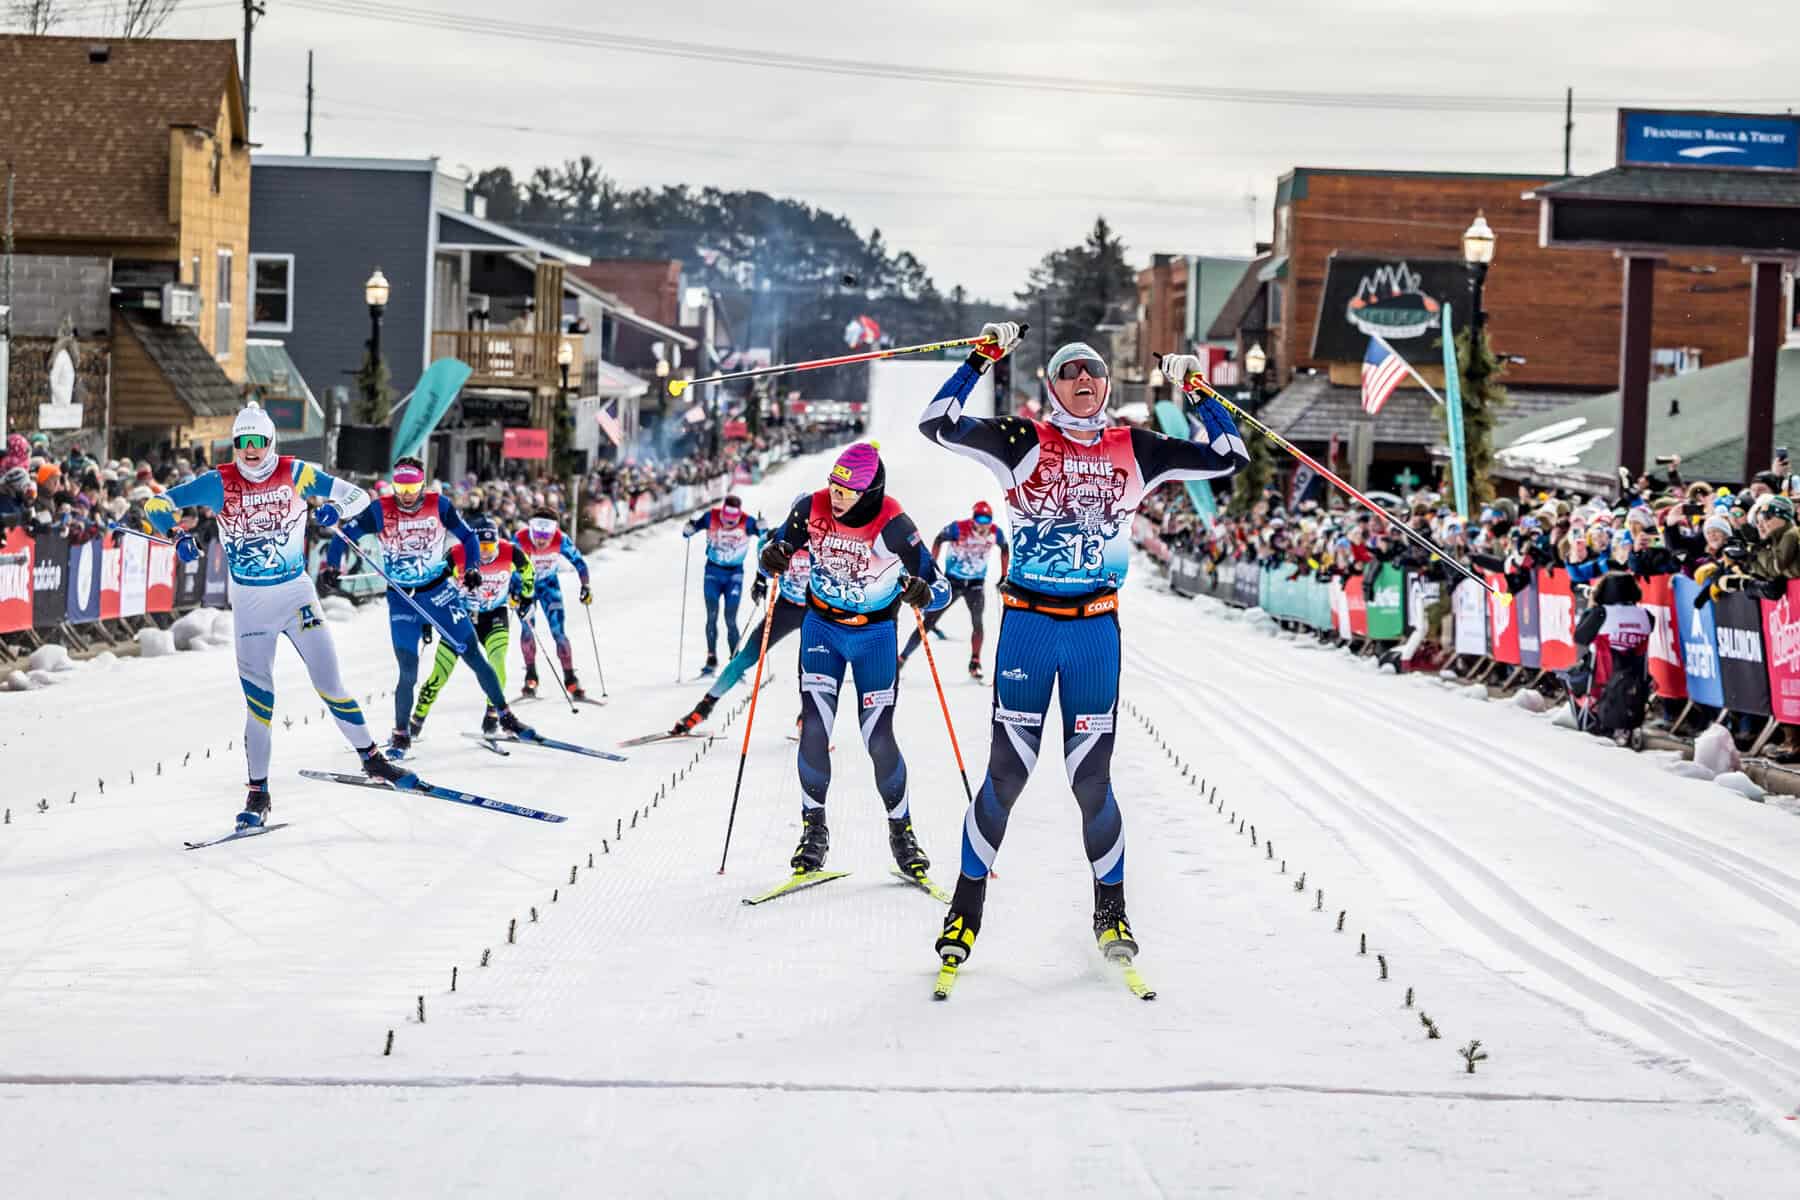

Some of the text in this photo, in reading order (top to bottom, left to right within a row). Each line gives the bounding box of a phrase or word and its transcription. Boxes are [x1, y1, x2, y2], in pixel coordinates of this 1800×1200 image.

[1063, 459, 1114, 477] BIRKIE
[262, 544, 278, 569] 2
[1066, 534, 1106, 570] 13
[1087, 600, 1115, 612] COXA
[1716, 626, 1763, 663] SALOMON
